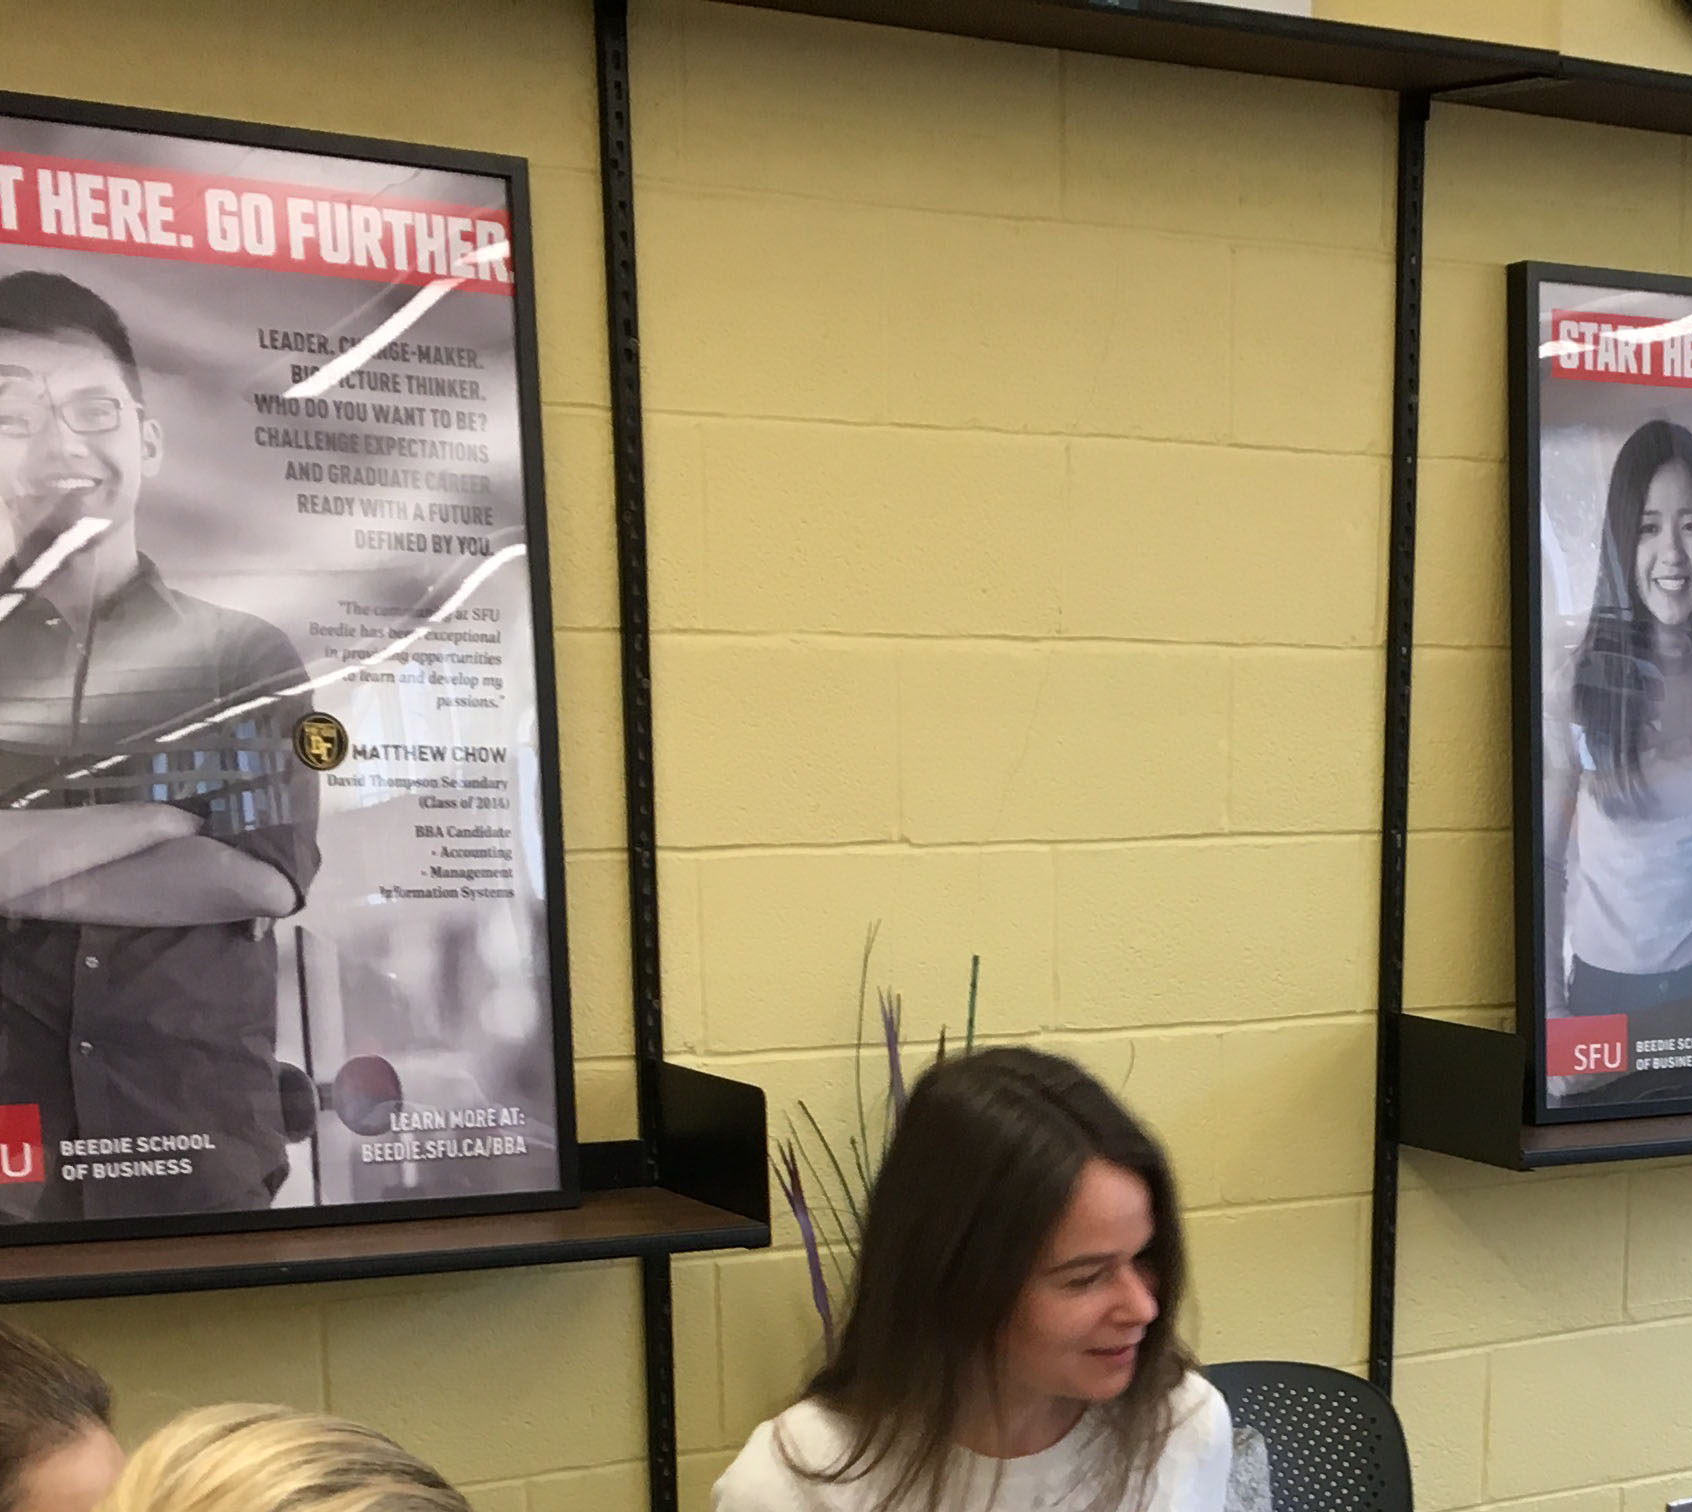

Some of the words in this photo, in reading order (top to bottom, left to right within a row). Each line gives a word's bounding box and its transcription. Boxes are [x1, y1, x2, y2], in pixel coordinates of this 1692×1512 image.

[37, 168, 194, 249] HERE.
[204, 188, 277, 257] GO
[257, 327, 335, 356] LEADER.
[406, 374, 487, 401] THINKER.
[253, 393, 300, 416] WHO
[304, 397, 330, 419] DO
[333, 400, 368, 423] YOU
[371, 402, 426, 427] WANT
[430, 407, 452, 430] TO
[456, 410, 488, 432] BE?
[254, 425, 361, 454] CHALLENGE
[363, 432, 490, 465] EXPECTATIONS
[284, 460, 324, 483] AND
[327, 463, 421, 490] GRADUATE
[425, 469, 491, 495] CAREER
[296, 492, 355, 517] READY
[359, 498, 408, 521] WITH
[412, 502, 426, 522] A
[428, 502, 495, 527] FUTURE
[354, 528, 428, 554] DEFINED
[431, 533, 454, 555] BY
[456, 535, 495, 557] YOU.
[471, 607, 500, 622] SFU
[351, 743, 446, 763] MATTHEW
[450, 745, 508, 763] CHOW
[326, 773, 366, 788] David
[414, 825, 445, 839] BBA
[1573, 1041, 1622, 1072] SFU
[1635, 1038, 1676, 1053] BEEDIE
[1635, 1058, 1651, 1071] OF
[389, 1111, 447, 1132] LEARN
[450, 1107, 498, 1129] MORE
[500, 1106, 526, 1126] AT:
[59, 1137, 134, 1157] BEEDIE
[135, 1133, 216, 1153] SCHOOL
[361, 1135, 528, 1163] BEEDIE.SFU.CA/BBA
[61, 1163, 89, 1181] OF
[92, 1158, 194, 1179] BUSINESS
